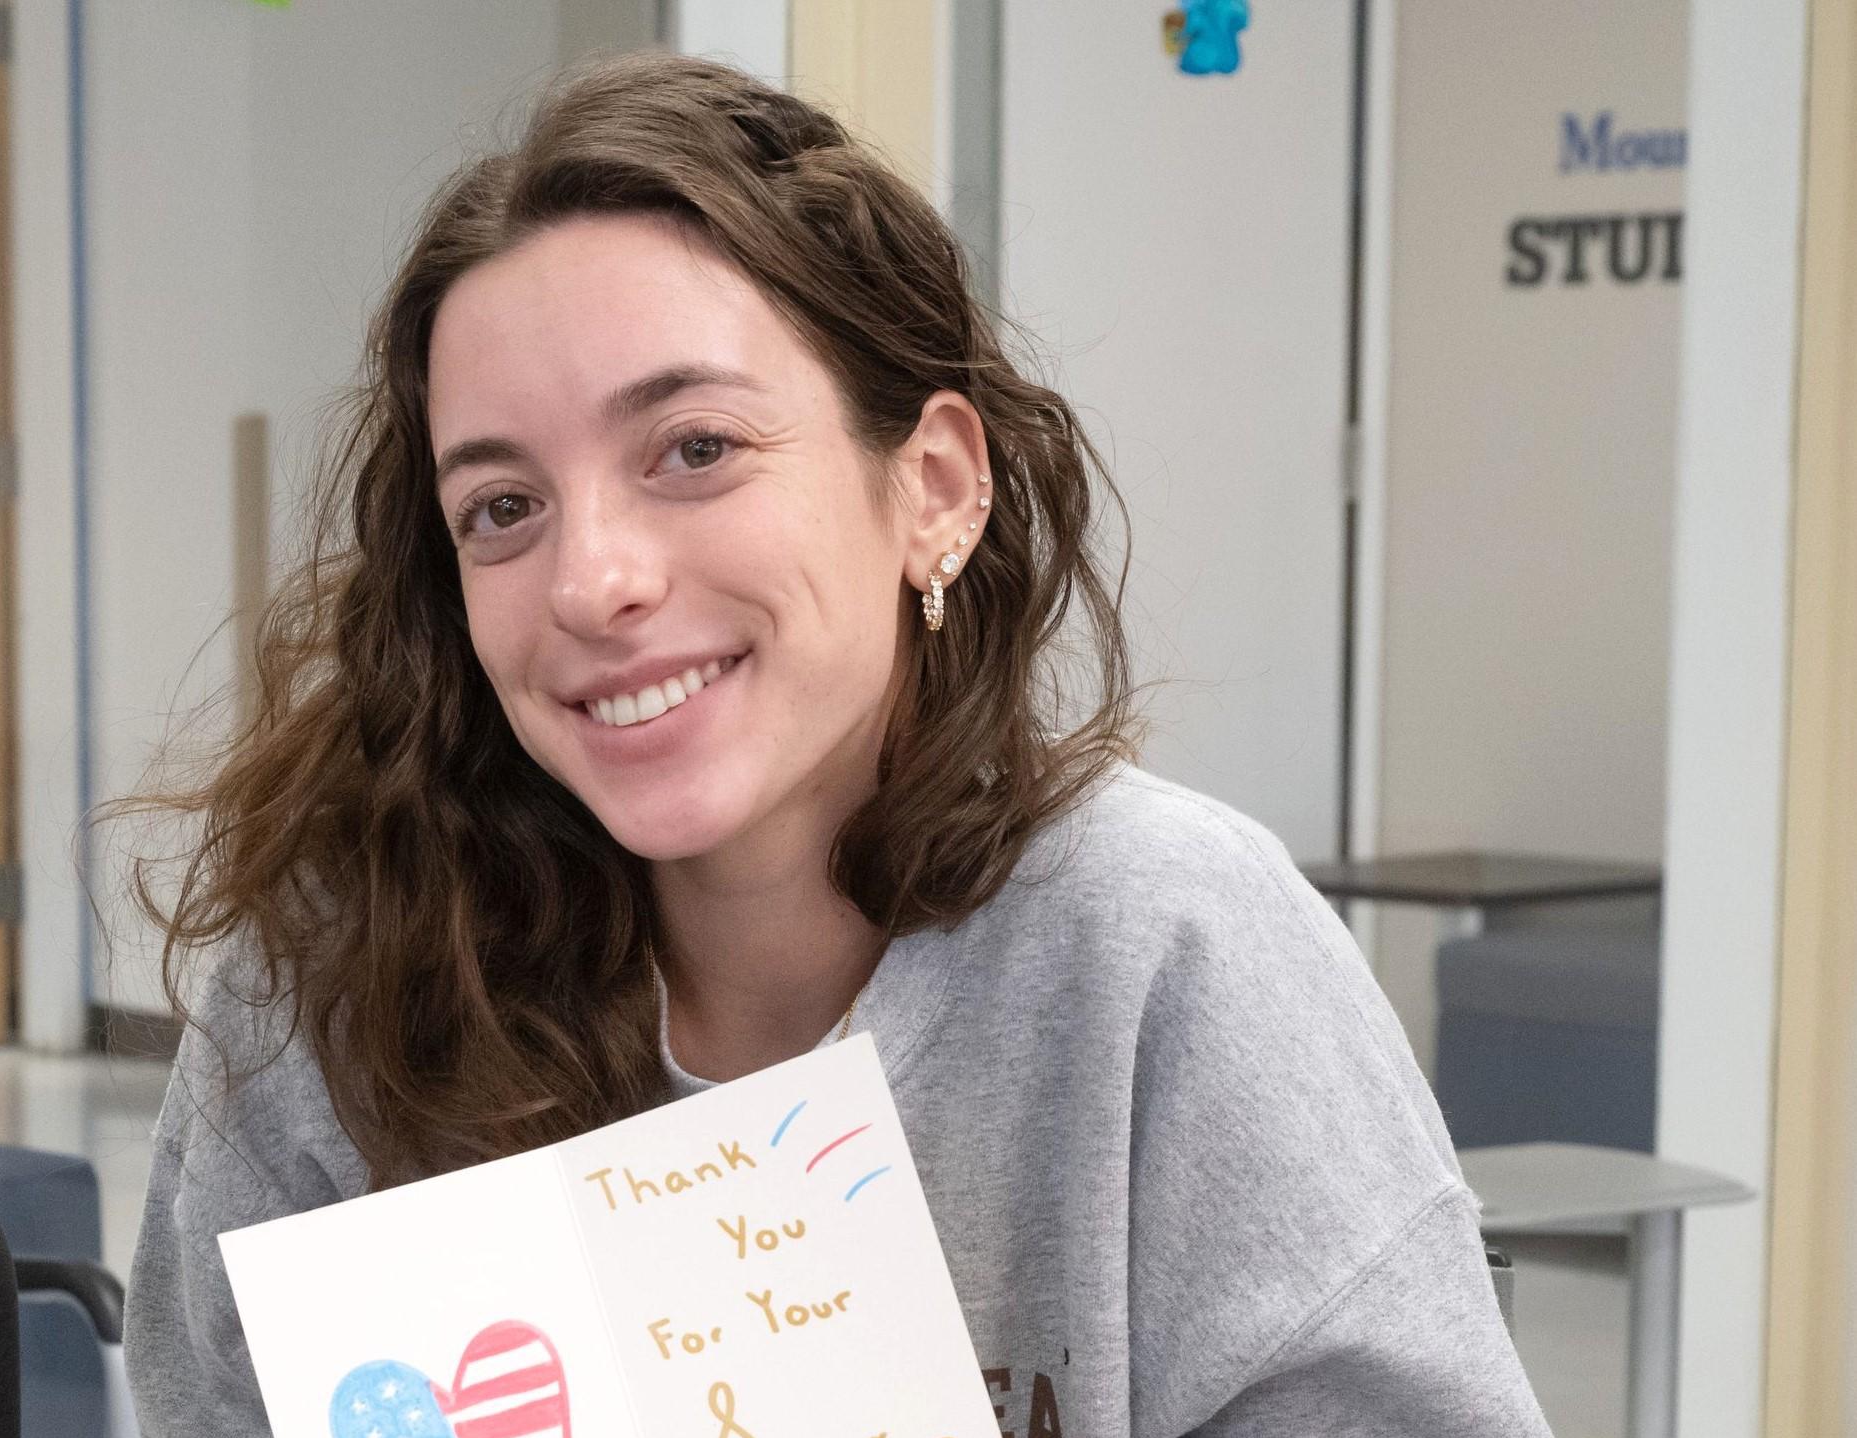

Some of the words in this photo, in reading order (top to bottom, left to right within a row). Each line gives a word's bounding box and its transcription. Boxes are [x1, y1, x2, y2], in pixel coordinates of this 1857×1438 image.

[584, 1141, 757, 1211] Thank
[716, 1215, 806, 1260] You
[647, 1318, 722, 1360] For
[745, 1289, 851, 1334] Your
